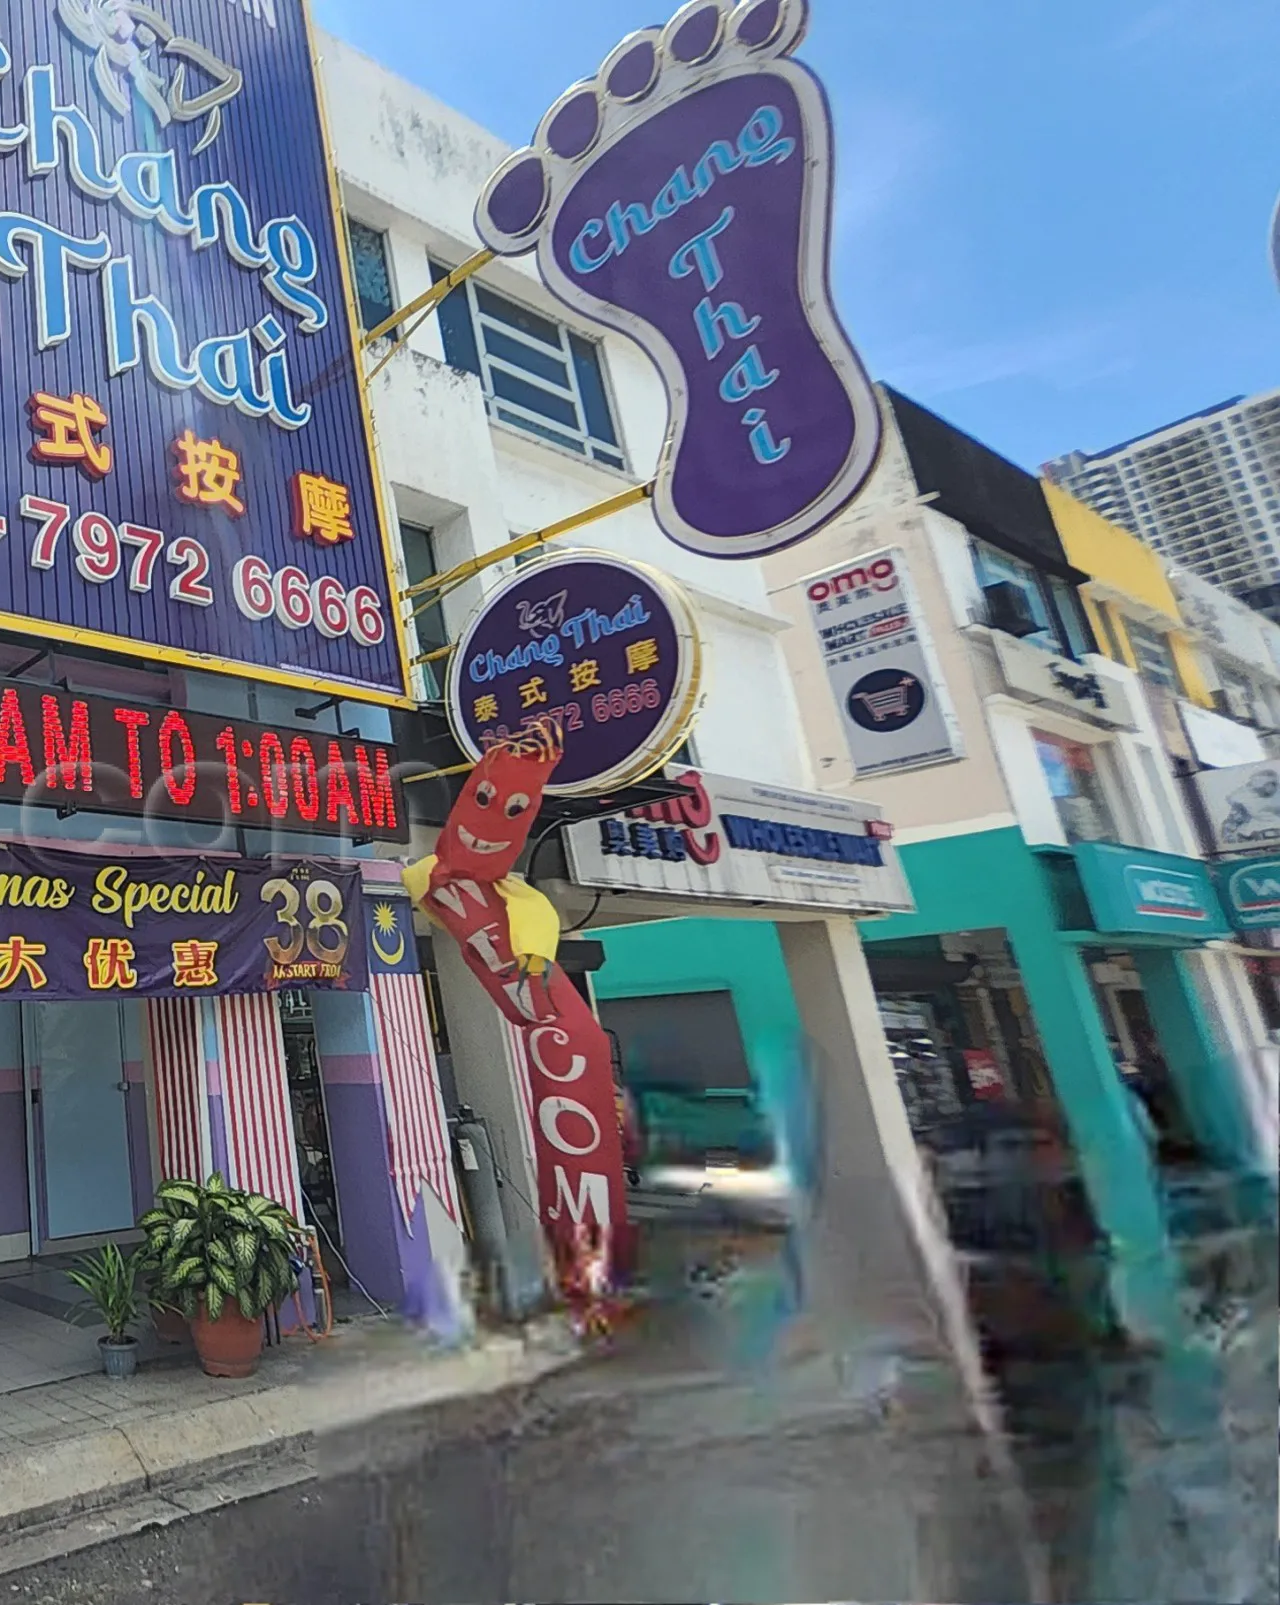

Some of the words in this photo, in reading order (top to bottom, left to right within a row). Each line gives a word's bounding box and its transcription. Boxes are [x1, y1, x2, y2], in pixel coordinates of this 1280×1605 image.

[569, 105, 796, 274] Chang
[668, 205, 792, 465] Thai
[233, 555, 386, 648] 6666
[807, 558, 900, 602] omg
[470, 633, 564, 683] Chang
[561, 594, 651, 649] Thai
[473, 638, 660, 724] 泰式按摩
[592, 678, 661, 723] 6666
[115, 707, 196, 805] TO
[216, 726, 397, 829] 1:00AM
[91, 866, 239, 929] Special
[261, 878, 348, 965] 38
